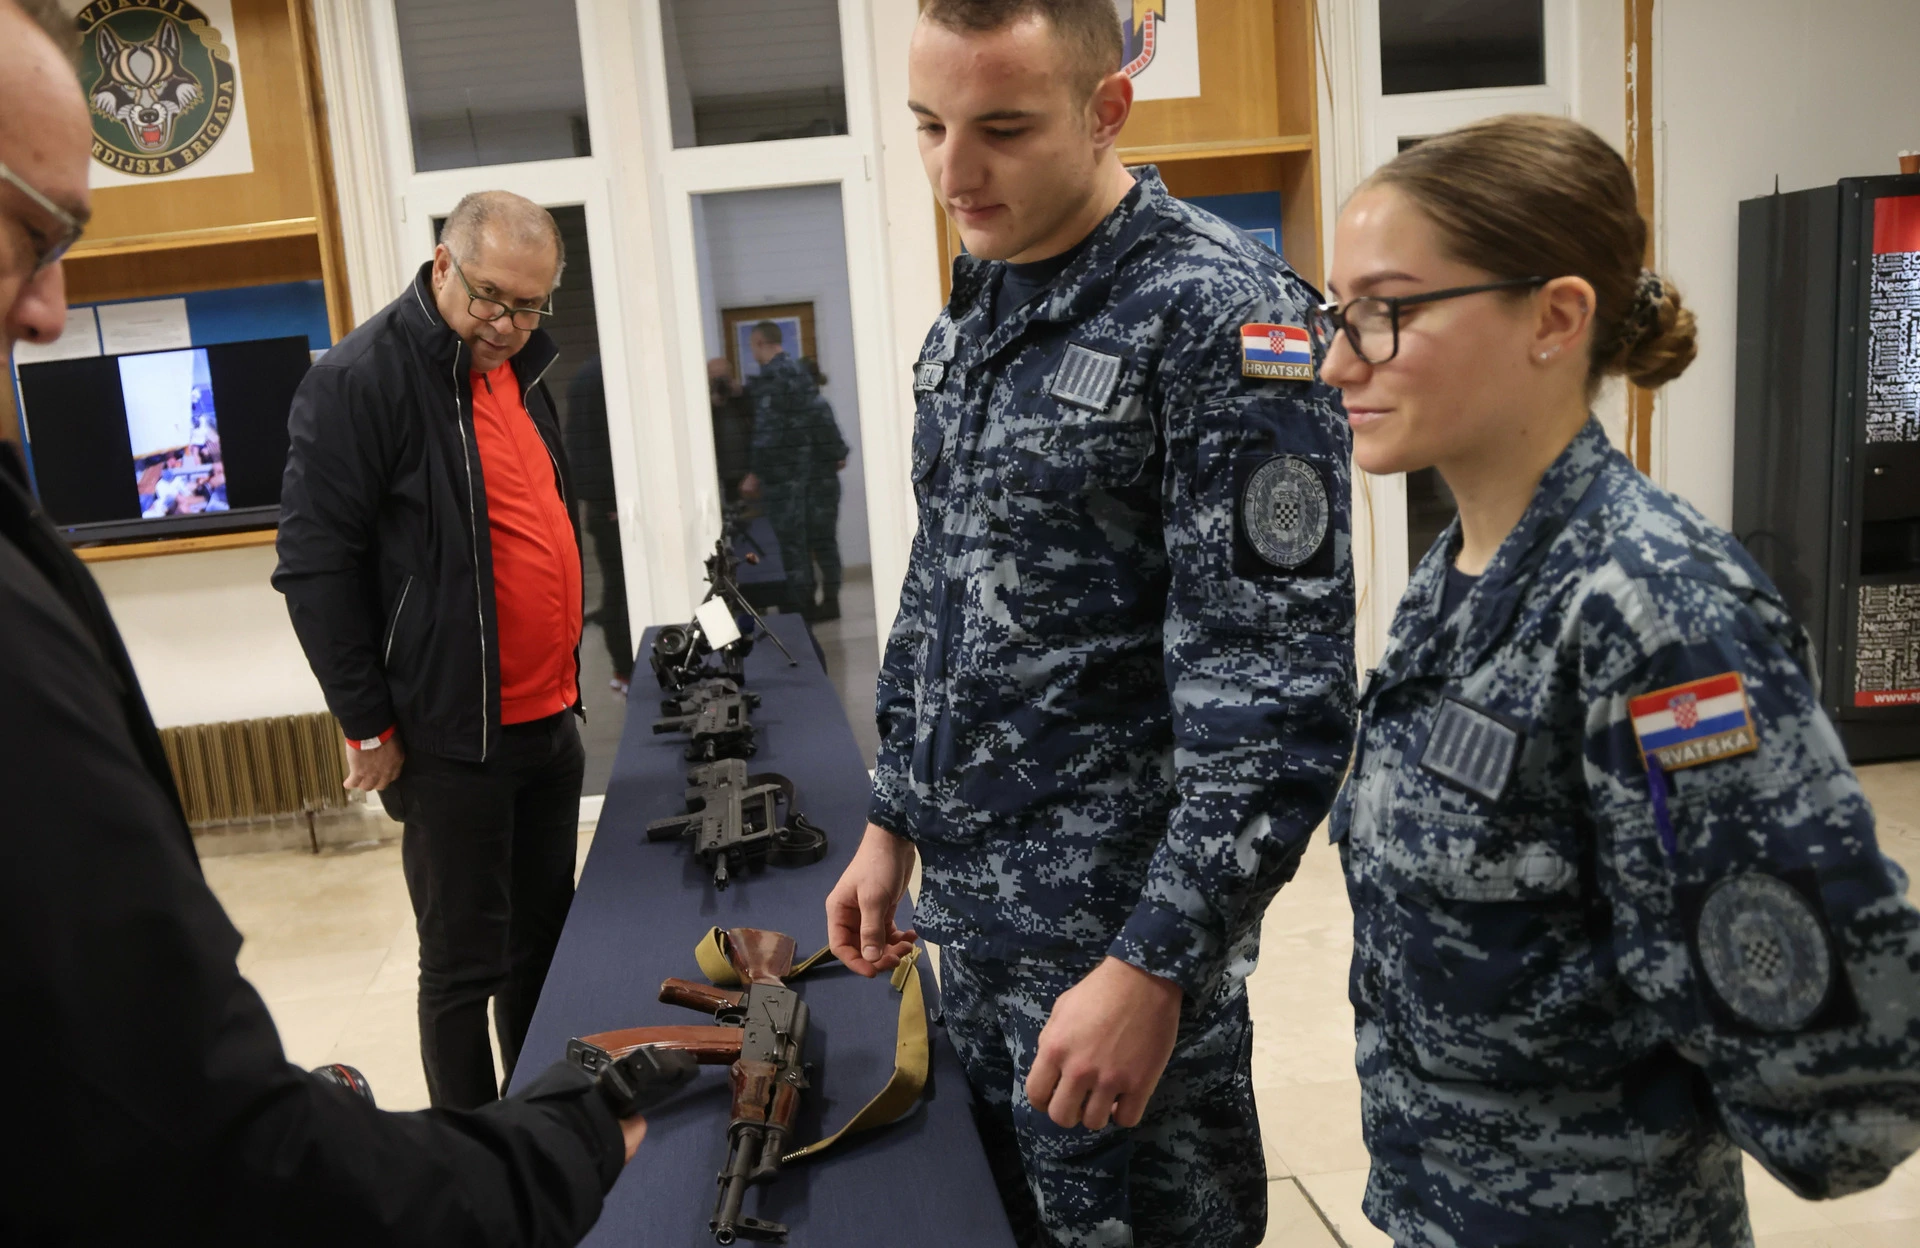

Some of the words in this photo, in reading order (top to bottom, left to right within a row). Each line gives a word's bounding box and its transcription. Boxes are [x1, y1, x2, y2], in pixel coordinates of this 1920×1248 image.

[92, 141, 176, 174] RDIJSKA
[180, 81, 233, 162] BRIGADA
[1245, 363, 1311, 378] HRVATSKA
[1659, 732, 1749, 765] RVATSKA
